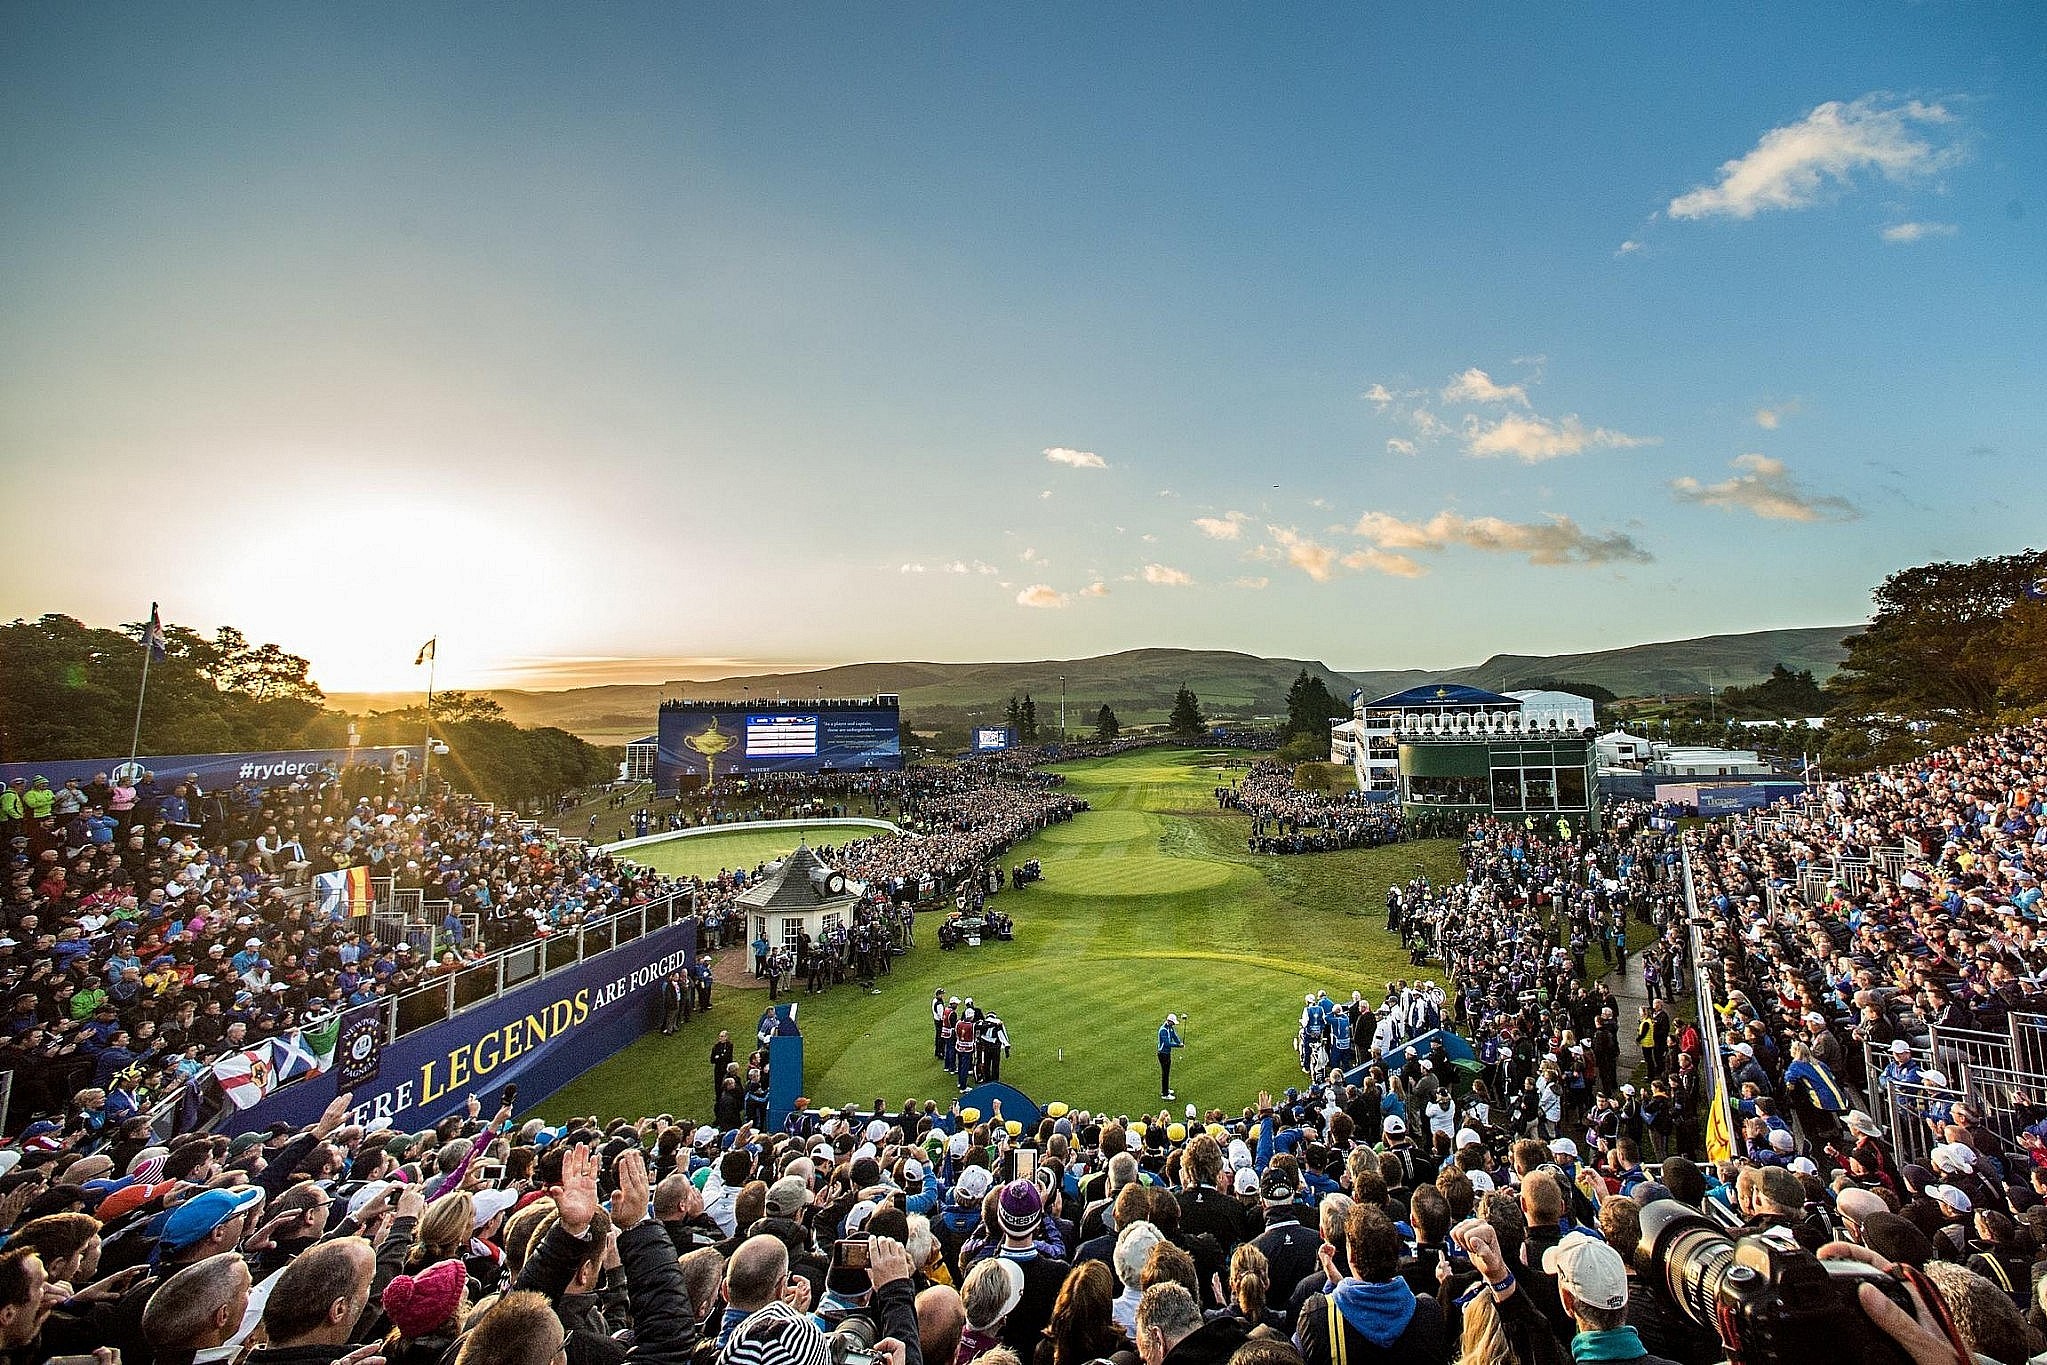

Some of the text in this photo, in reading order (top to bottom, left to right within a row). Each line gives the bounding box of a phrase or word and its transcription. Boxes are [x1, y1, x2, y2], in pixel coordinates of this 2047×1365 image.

[757, 771, 806, 781] LEGENDS
[342, 1018, 380, 1040] NEWPORT
[351, 1079, 414, 1126] ERE
[418, 988, 589, 1108] LEGENDS
[592, 977, 627, 1011] ARE
[629, 949, 686, 993] FORGED
